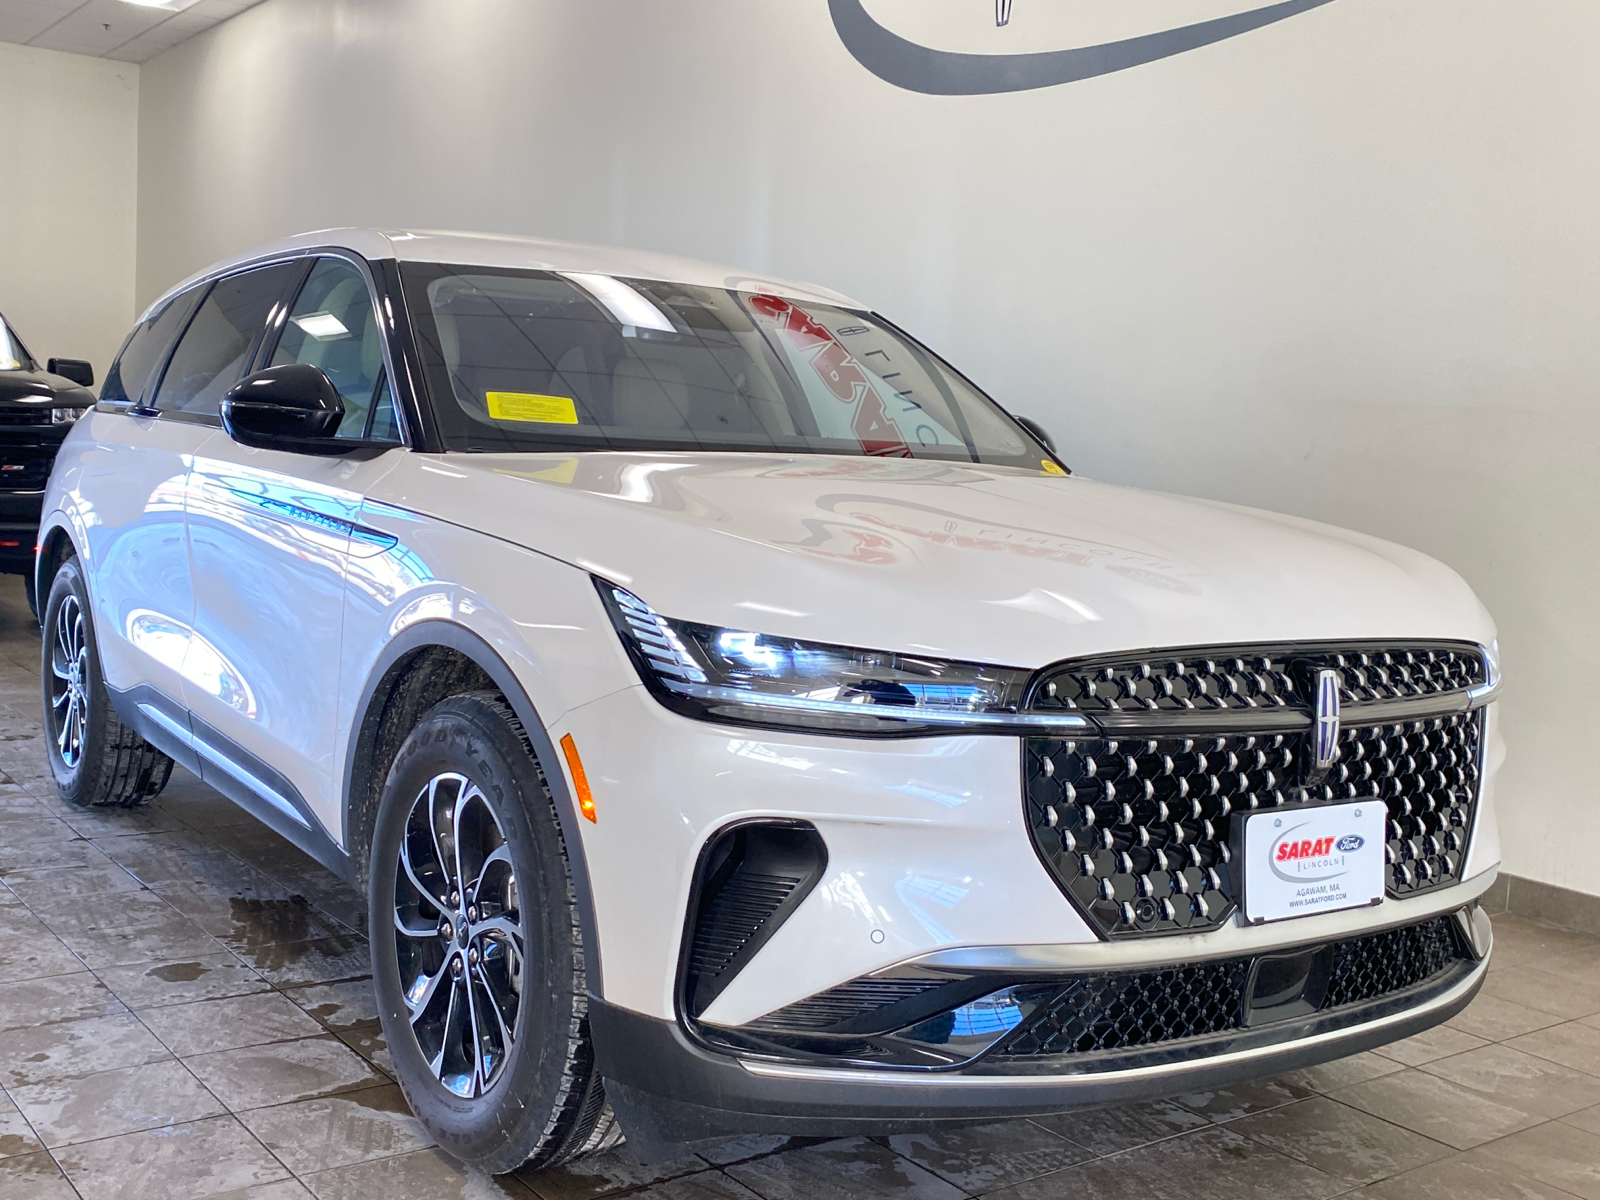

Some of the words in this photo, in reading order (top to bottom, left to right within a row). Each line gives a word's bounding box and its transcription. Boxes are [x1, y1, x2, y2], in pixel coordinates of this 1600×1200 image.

[289, 506, 350, 533] NAUTILUS
[393, 727, 519, 842] GOODYEAR
[1275, 836, 1336, 862] SARAT
[1340, 837, 1360, 850] Ford
[1303, 858, 1339, 870] LINCOLN
[1289, 892, 1347, 908] WWW.SARATFORD.COM
[1296, 885, 1328, 897] AGAWAM,
[1329, 883, 1341, 892] MA
